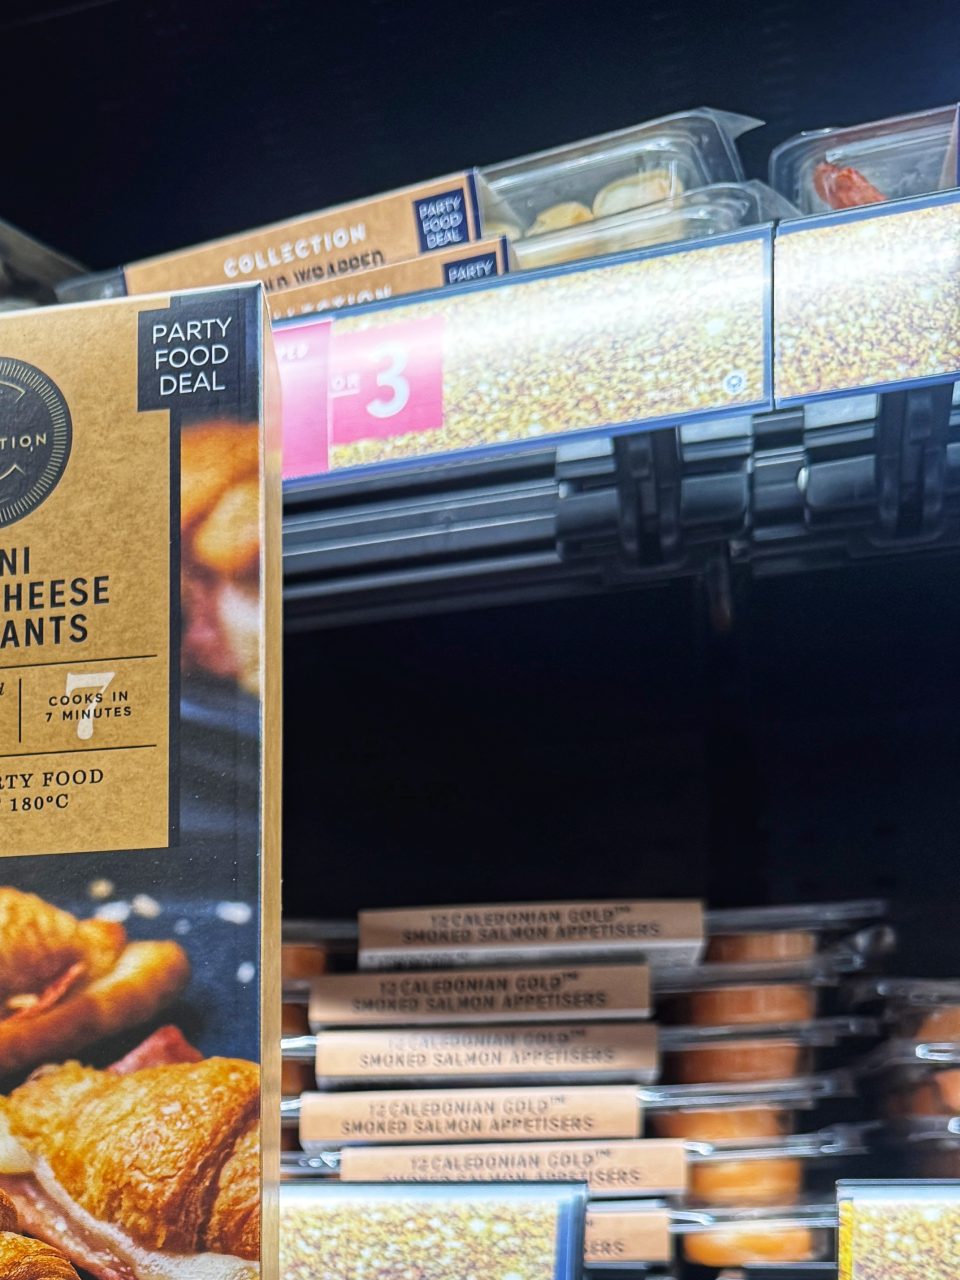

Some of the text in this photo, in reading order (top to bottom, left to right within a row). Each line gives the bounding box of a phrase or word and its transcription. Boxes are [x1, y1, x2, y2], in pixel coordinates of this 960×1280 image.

[223, 223, 367, 278] COLLECTION
[152, 316, 232, 344] PARTY
[155, 344, 229, 370] FOOD
[160, 370, 226, 396] DEAL
[365, 342, 410, 418] 3
[48, 690, 128, 707] COOKS IN
[65, 671, 116, 740] 7
[45, 706, 132, 722] 7 MINUTES
[42, 768, 105, 787] FOOD
[402, 923, 661, 944] SMOKED SALMON APPETISERS
[399, 975, 508, 995] CALEDONIAN
[425, 994, 497, 1012] SALMON
[502, 991, 607, 1009] APPETISERS
[359, 1048, 616, 1069] SMOKED SALMON APPETISERS
[388, 1099, 495, 1117] CALEDONIAN
[341, 1115, 595, 1135] SMOKED SALMON APPETISERS
[431, 1154, 540, 1171] CALEDONIAN
